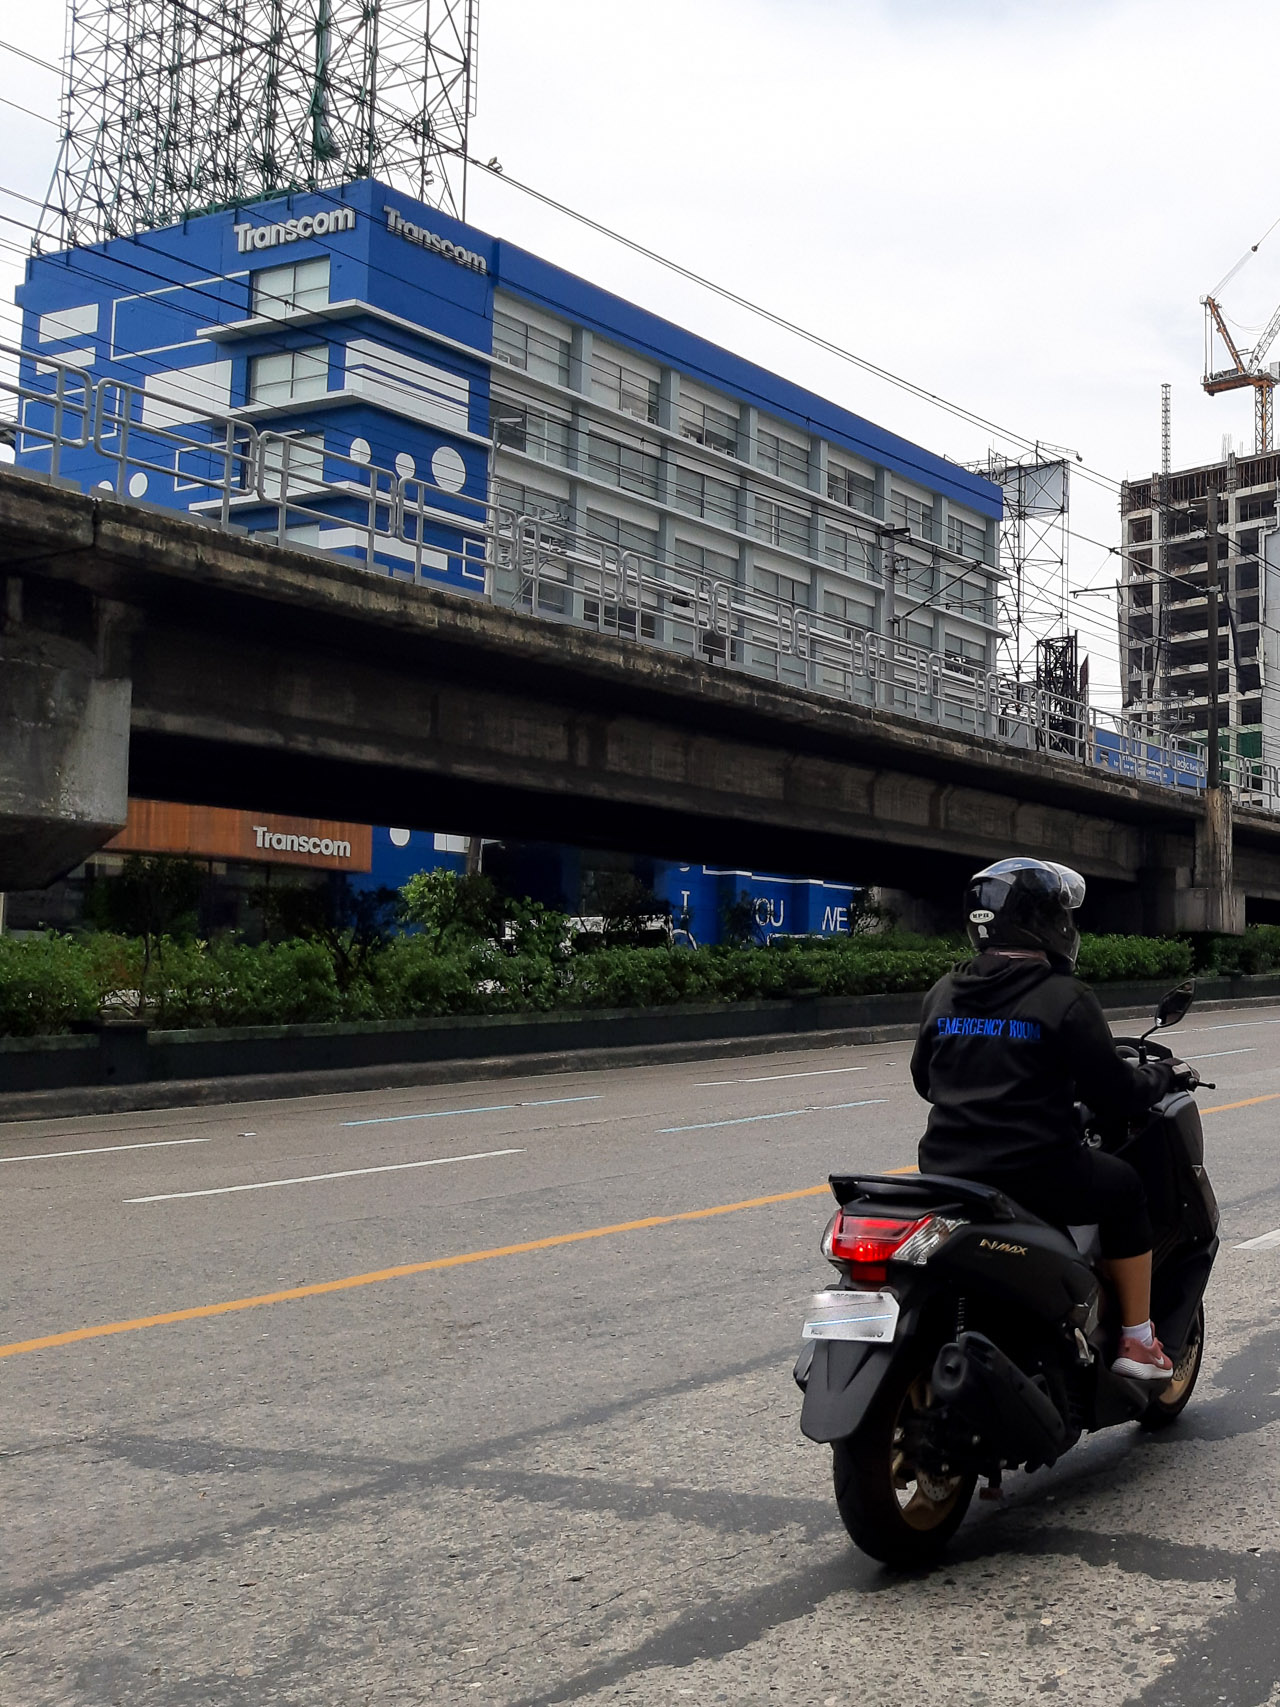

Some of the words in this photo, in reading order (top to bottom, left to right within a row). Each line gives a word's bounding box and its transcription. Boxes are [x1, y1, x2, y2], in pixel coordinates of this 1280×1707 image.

[233, 206, 355, 253] Transcom
[384, 205, 488, 275] Transcom
[252, 825, 351, 857] Transcom
[937, 1017, 1006, 1036] EMERGENCY
[1009, 1019, 1041, 1039] ROOM
[979, 1238, 1028, 1256] NMAX
